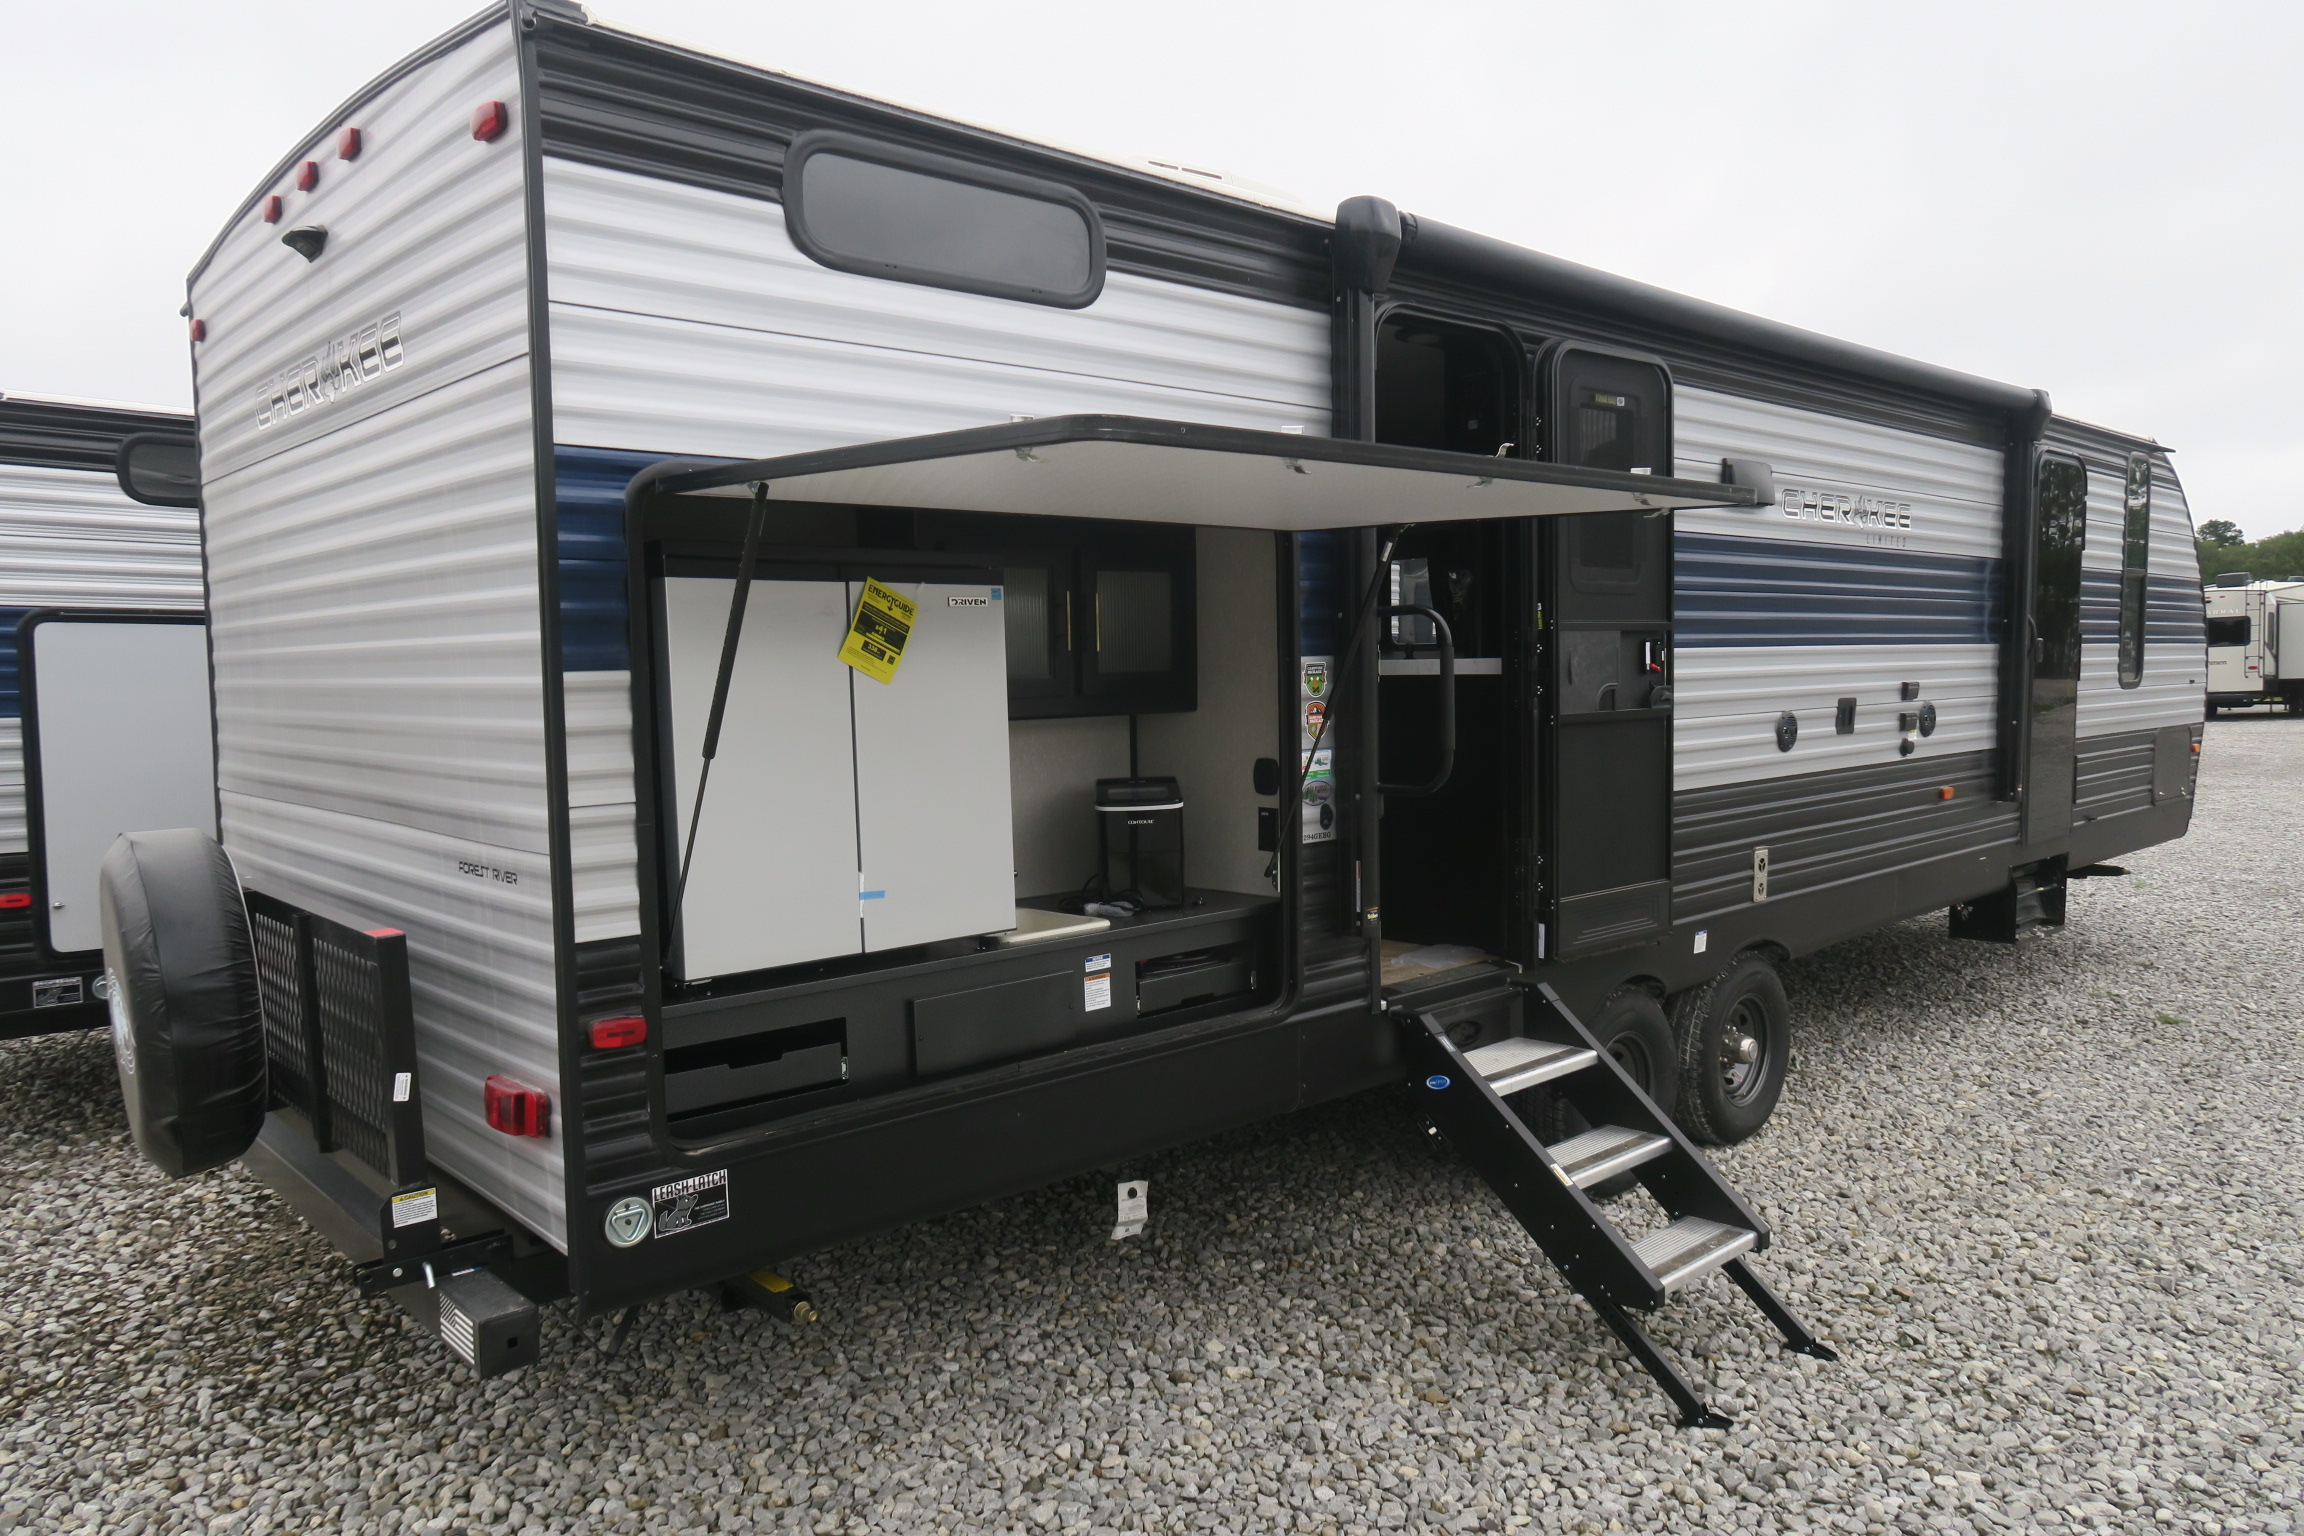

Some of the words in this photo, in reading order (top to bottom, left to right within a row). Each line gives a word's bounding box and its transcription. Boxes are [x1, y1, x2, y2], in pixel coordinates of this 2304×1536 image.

[1866, 533, 1906, 548] LIMITED
[951, 598, 987, 606] DRIVEN
[458, 861, 490, 878] FOREST
[492, 868, 518, 885] RIVER
